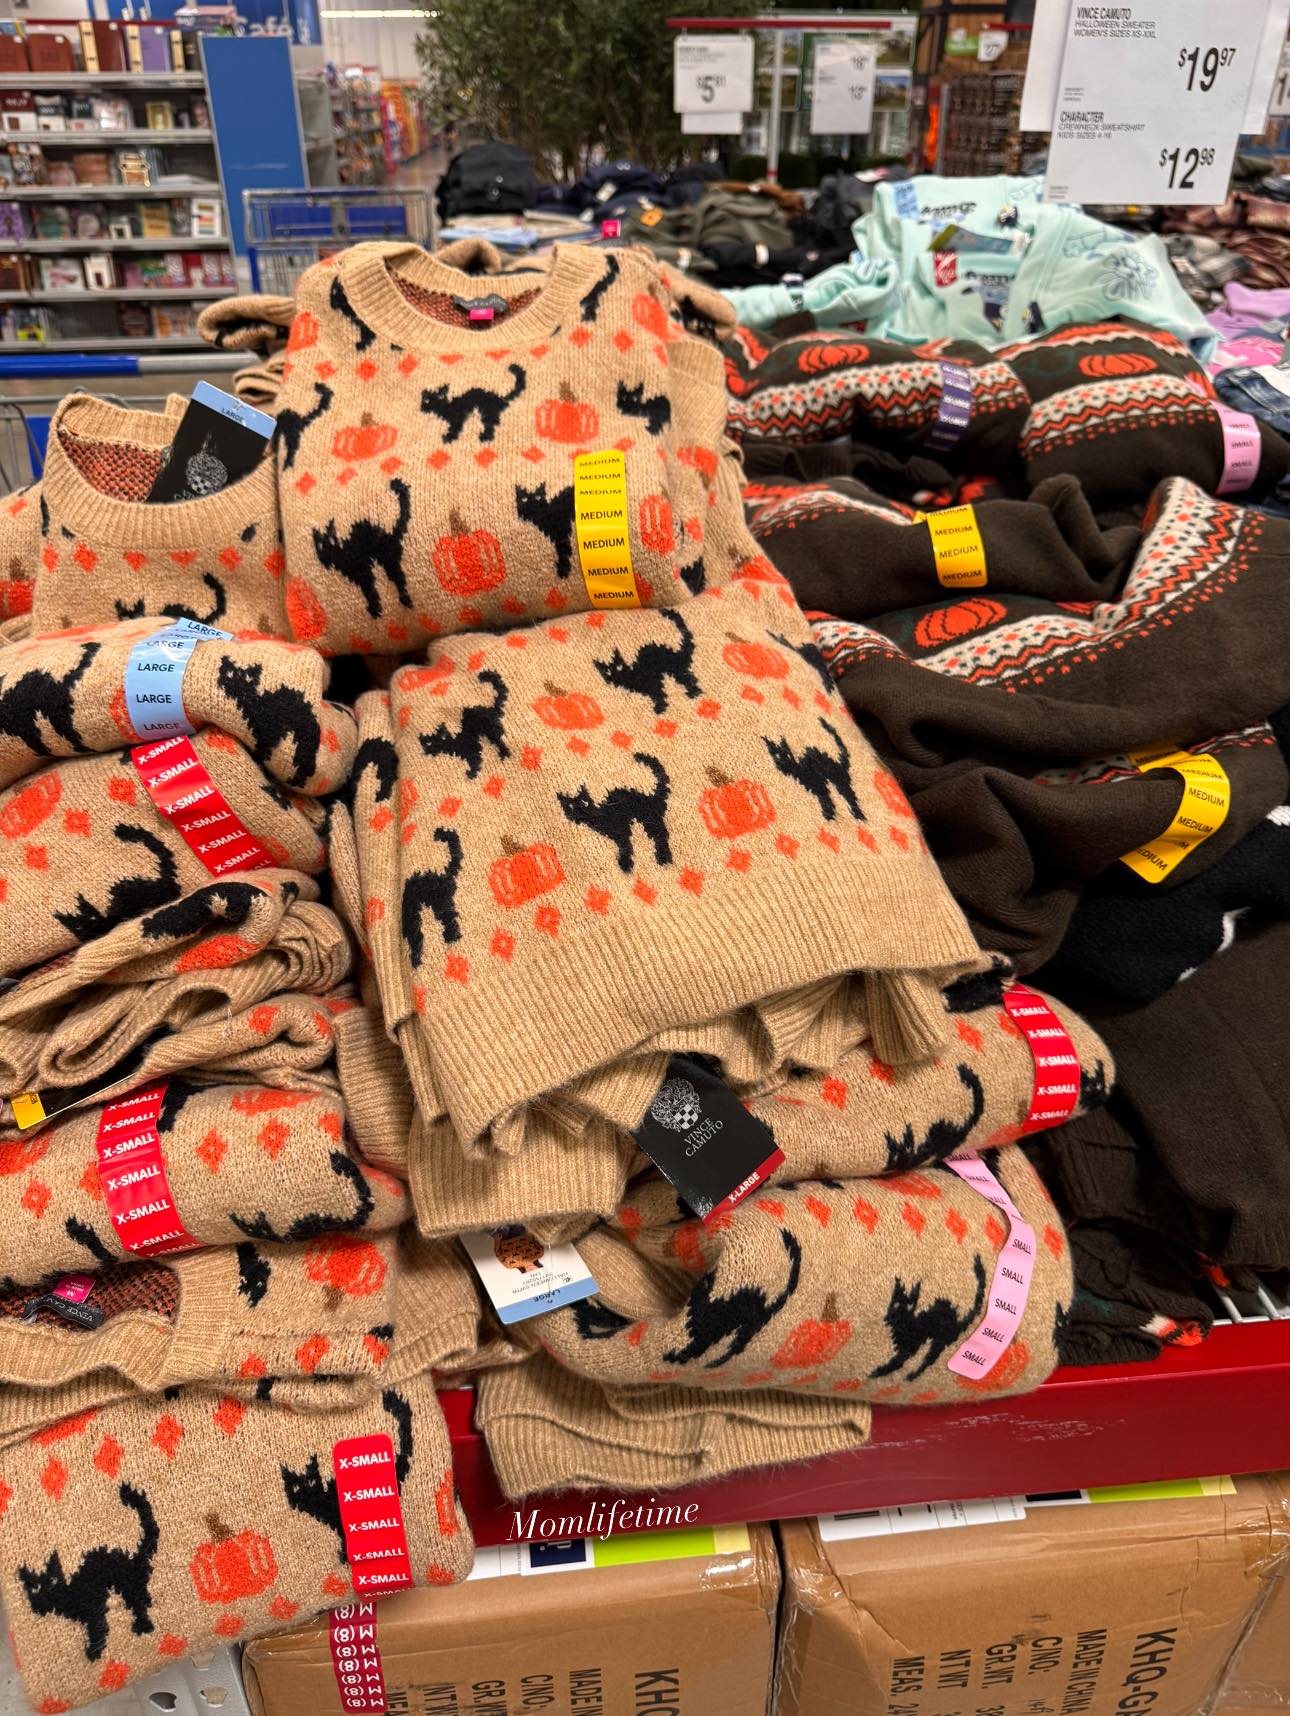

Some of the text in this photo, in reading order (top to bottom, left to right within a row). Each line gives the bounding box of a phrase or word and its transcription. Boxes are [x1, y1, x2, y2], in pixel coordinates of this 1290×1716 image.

[1077, 7, 1132, 20] VINCE CAMUTO
[1075, 20, 1156, 29] HALLOWEEN SWEATER
[1073, 29, 1109, 37] WOMEN'S
[1109, 30, 1130, 38] SIZES
[1060, 111, 1104, 122] CHARACTER
[579, 458, 621, 468] MEDIUM
[579, 473, 621, 481] MEDIUM
[580, 510, 623, 520] MEDIUM
[935, 526, 973, 536] MEDIUM
[583, 538, 625, 550] MEDIUM
[939, 545, 978, 559] MEDIUM
[588, 566, 629, 577] MEDIUM
[943, 569, 982, 581] MEDIUM
[594, 591, 634, 600] MEDIUM
[187, 621, 223, 637] LARGE
[146, 640, 185, 649] LARGE
[137, 663, 175, 672] LARGE
[136, 694, 173, 704] LARGE
[143, 722, 180, 731] LARGE
[137, 736, 185, 765] X-SMALL
[148, 757, 198, 788] X-SMALL
[164, 785, 215, 815] X-SMALL
[1188, 787, 1225, 807] MEDIUM
[181, 810, 231, 833] X-SMALL
[1177, 816, 1213, 833] MEDIUM
[197, 829, 247, 854] X-SMALL
[213, 847, 260, 873] X-SMALL
[1137, 848, 1168, 871] EDIUM
[1010, 1007, 1050, 1017] X-SMALL
[1027, 1028, 1066, 1038] X-SMALL
[1038, 1055, 1077, 1067] X-SMALL
[1037, 1084, 1077, 1096] X-SMALL
[108, 1093, 160, 1111] X-SMALL
[103, 1112, 156, 1133] X-SMALL
[1031, 1109, 1069, 1121] X-SMALL
[684, 1117, 715, 1145] VINCE
[685, 1120, 724, 1157] CAMUTO
[102, 1132, 155, 1159] X-SMALL
[107, 1165, 161, 1191] X-SMALL
[728, 1171, 760, 1203] X-LARGE
[115, 1199, 171, 1225] X-SMALL
[129, 1229, 185, 1251] X-SMALL
[1012, 1238, 1032, 1255] SMALL
[1001, 1267, 1023, 1284] SMALL
[533, 1289, 561, 1302] LARGE
[67, 1306, 93, 1321] VINCE
[995, 1298, 1017, 1315] SMALL
[981, 1327, 1005, 1343] SMALL
[962, 1350, 986, 1366] SMALL
[339, 1451, 391, 1469] X-SMALL
[343, 1486, 395, 1503] X-SMALL
[349, 1517, 400, 1532] X-SMALL
[353, 1548, 405, 1561] X-SMALL
[358, 1573, 409, 1585] X-SMALL
[335, 1602, 373, 1620] M (8)
[334, 1624, 374, 1643] M (8)
[336, 1644, 375, 1657] M (8)
[339, 1657, 378, 1672] M (8)
[939, 1649, 972, 1669] NT
[341, 1673, 380, 1684] M (8)
[889, 1655, 925, 1697] MEAS.
[937, 1669, 970, 1689] WT
[1059, 1629, 1107, 1716] MADE IN CHINA
[344, 1685, 382, 1696] M (8)
[423, 1684, 457, 1702] NT
[569, 1668, 602, 1705] MADE
[346, 1697, 384, 1707] M (8)
